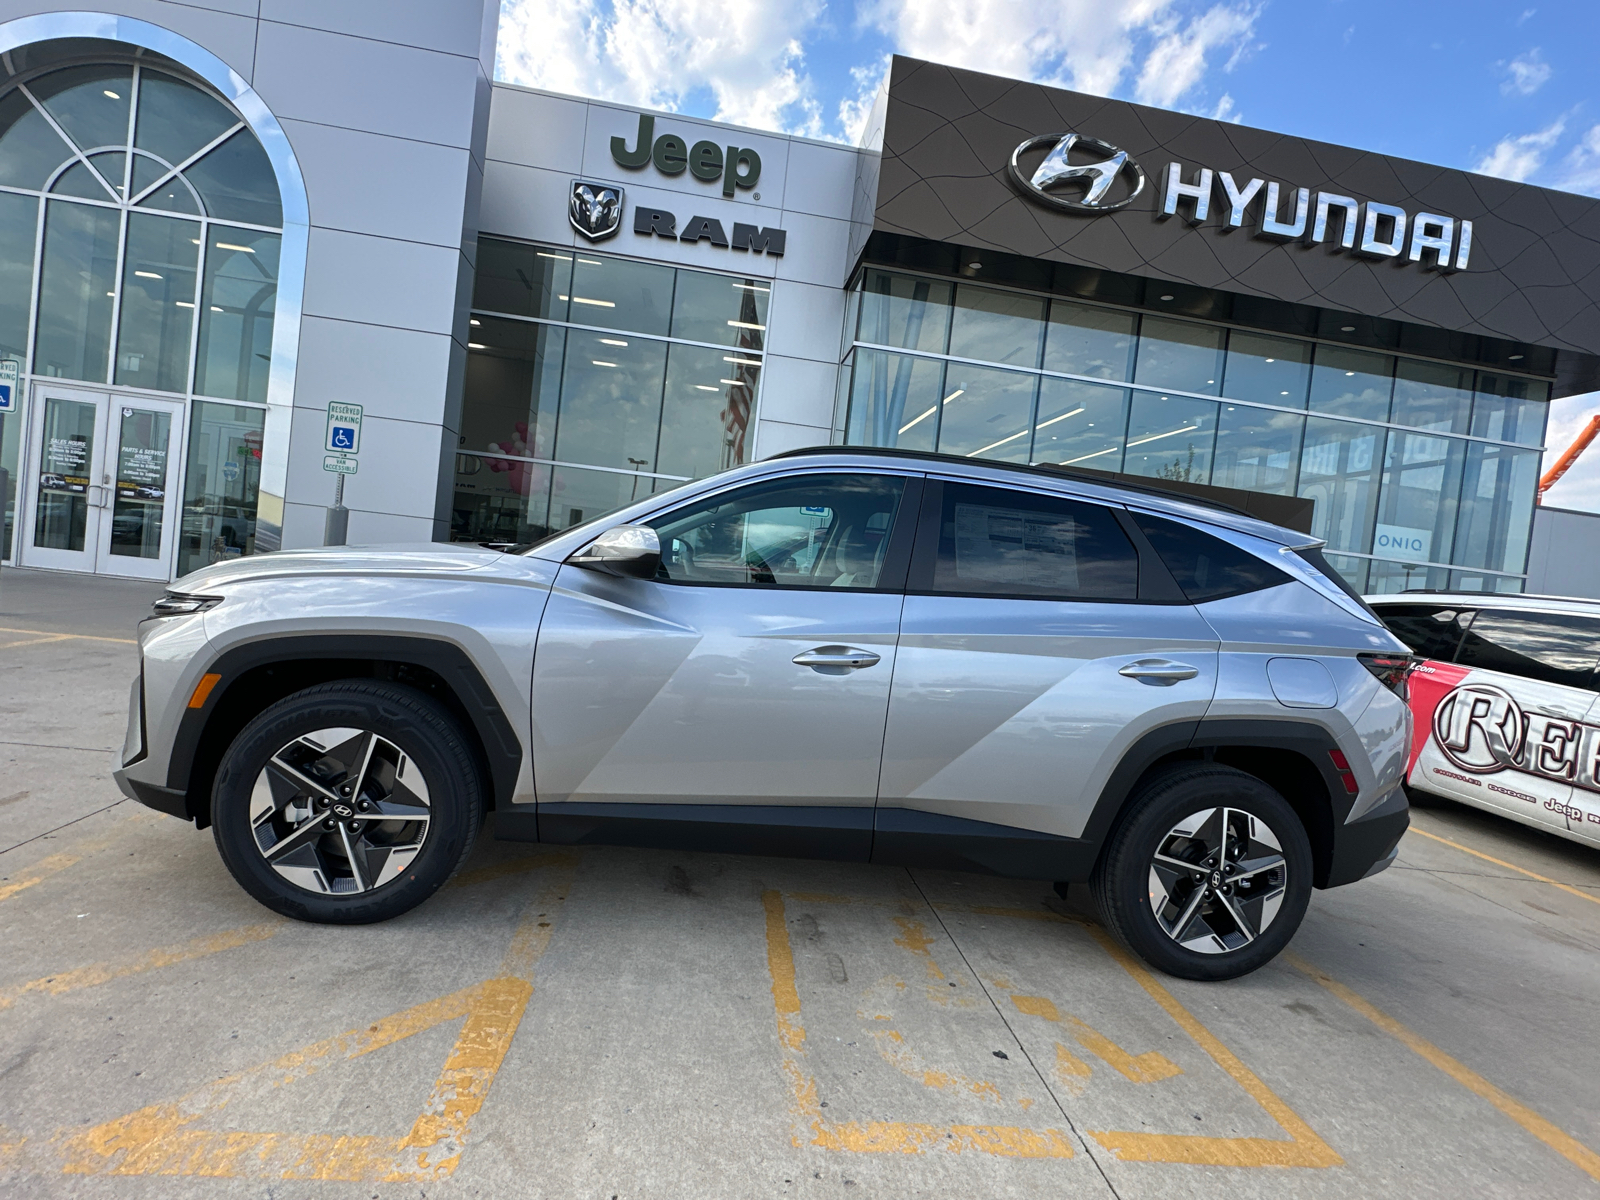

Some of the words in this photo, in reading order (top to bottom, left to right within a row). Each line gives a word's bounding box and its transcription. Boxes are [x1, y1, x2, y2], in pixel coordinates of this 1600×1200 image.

[610, 114, 762, 197] Jeep
[1157, 161, 1473, 270] HYUNDAI
[633, 205, 787, 257] RAM
[330, 414, 359, 424] PARKING
[331, 405, 360, 416] RESERVED
[121, 446, 138, 454] PARTS
[144, 449, 166, 457] SERVICE
[325, 464, 356, 472] ACCESSIBLE
[1378, 534, 1423, 552] ONIQ
[1487, 783, 1537, 804] DODGE
[1543, 797, 1583, 822] Jeep
